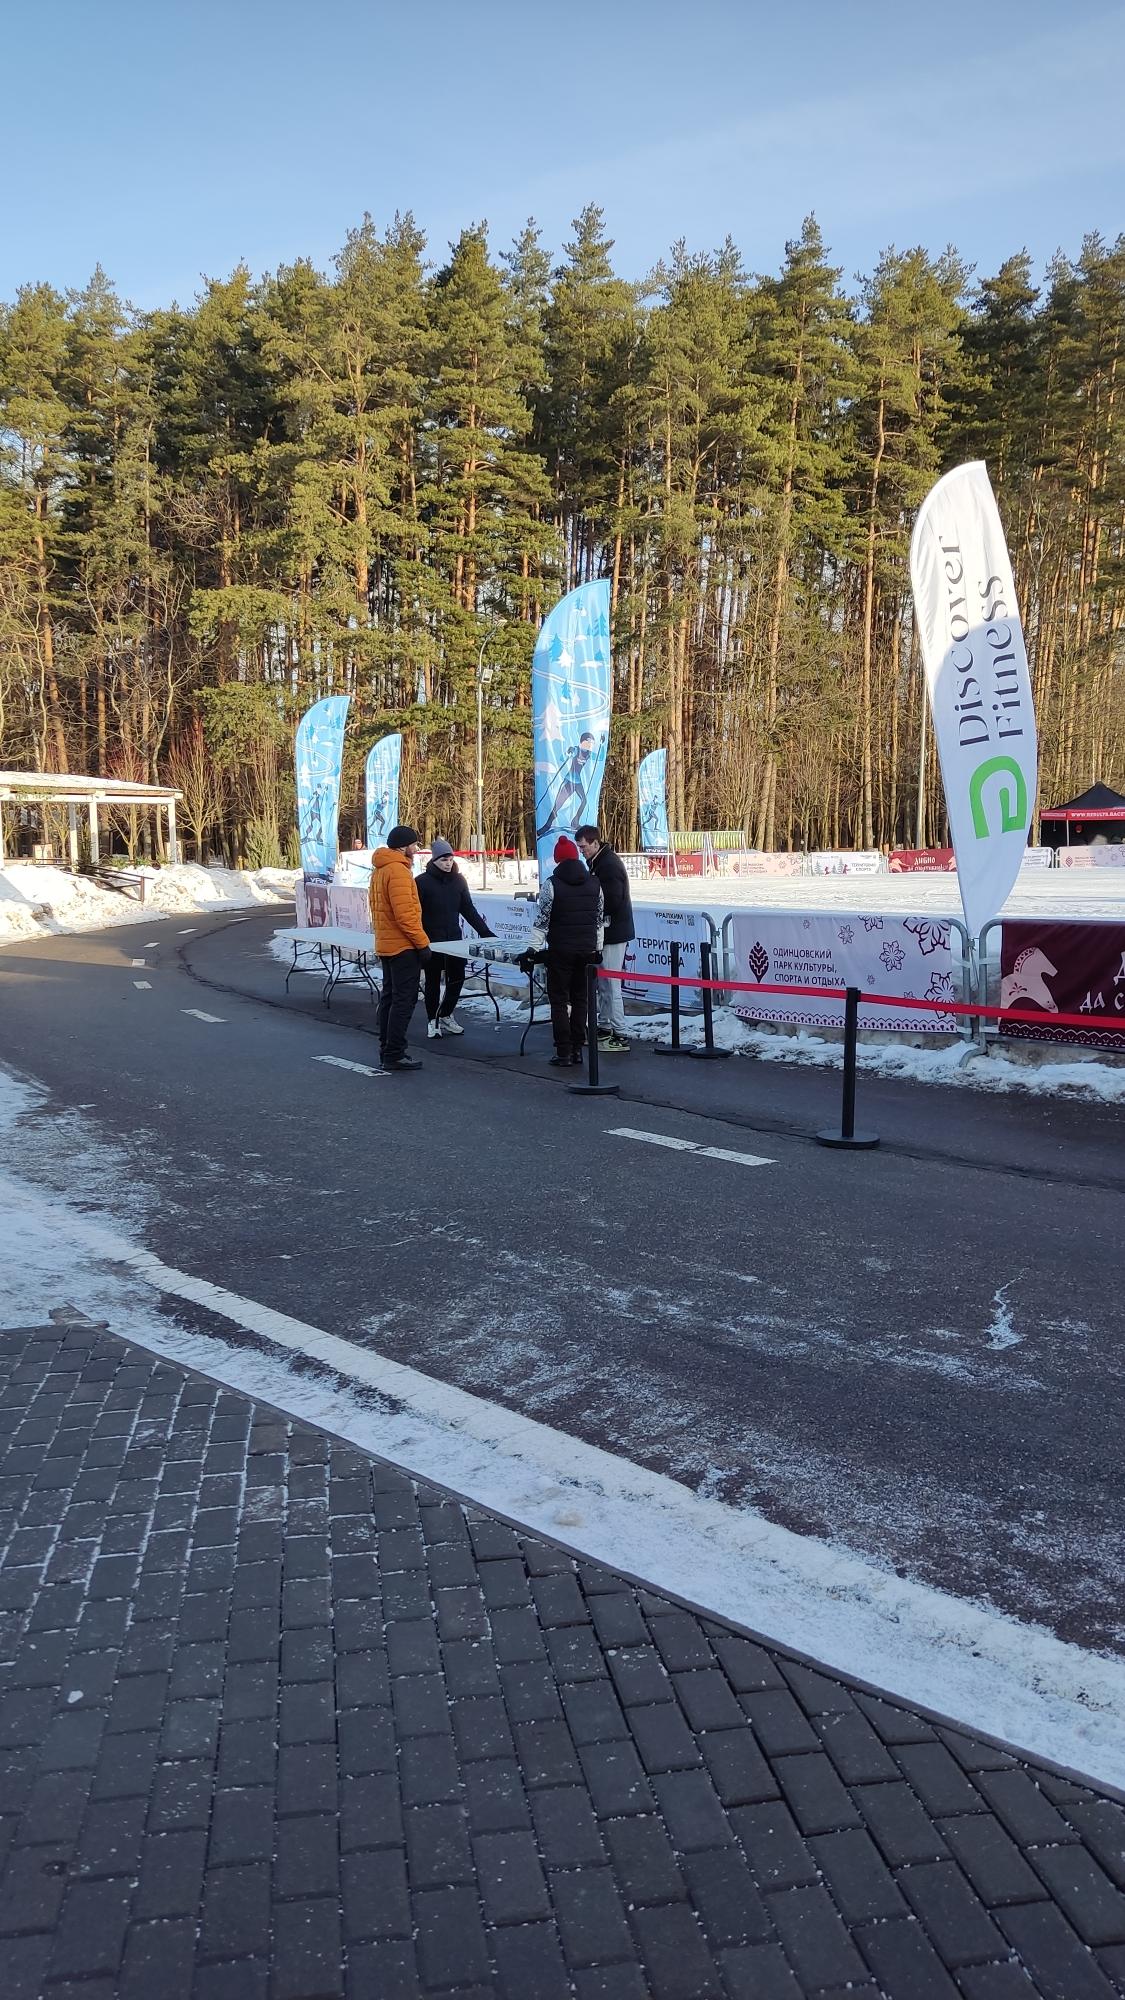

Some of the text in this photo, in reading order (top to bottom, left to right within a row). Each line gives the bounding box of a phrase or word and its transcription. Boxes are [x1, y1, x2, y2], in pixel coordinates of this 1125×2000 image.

[939, 536, 990, 747] Discover
[977, 575, 1024, 739] Fitness
[655, 912, 683, 920] УРАЛХИМ
[637, 938, 696, 954] ТЕРРИТРИЯ
[773, 947, 832, 959] ОДИНЦОВСКИЙ
[648, 954, 685, 967] СПОРА
[773, 961, 837, 974] ПАРК КУЛЬТУРЫ,
[774, 973, 846, 987] СПОРТА И ОТДЫХА
